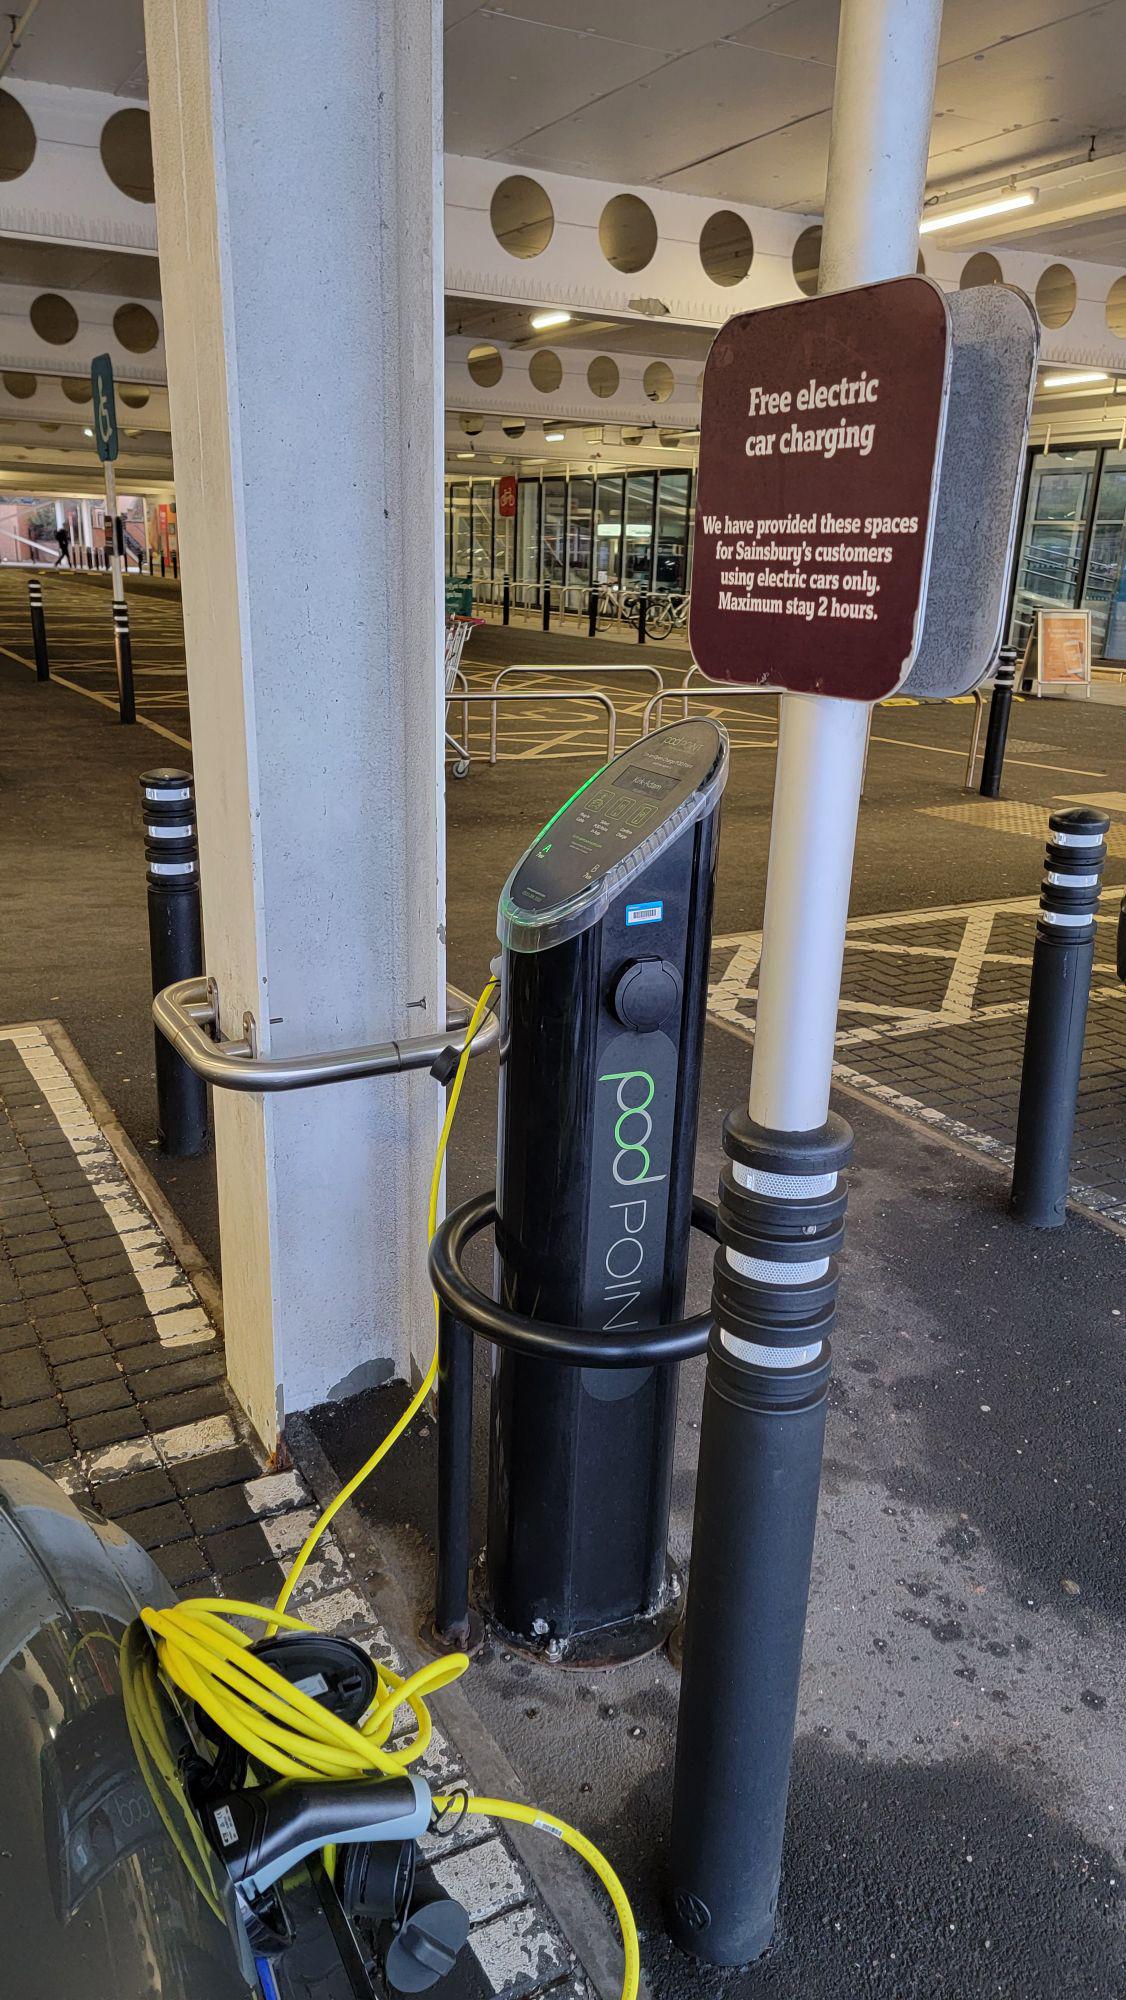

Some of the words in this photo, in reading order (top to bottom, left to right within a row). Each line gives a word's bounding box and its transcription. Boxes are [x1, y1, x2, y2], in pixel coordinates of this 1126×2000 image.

[749, 387, 791, 416] Free
[797, 371, 878, 410] electric
[746, 434, 776, 456] car
[780, 418, 875, 458] charging
[703, 516, 721, 534] We
[724, 516, 754, 534] have
[756, 514, 817, 539] provided
[821, 513, 861, 533] these
[864, 517, 918, 539] spaces
[716, 541, 733, 559] for
[736, 541, 812, 566] Sainsbury's
[815, 544, 892, 562] customers
[721, 567, 754, 590] using
[757, 568, 807, 588] electric
[810, 574, 839, 589] cars
[843, 570, 880, 596] only.
[718, 592, 782, 613] Maximum
[786, 597, 814, 620] stay
[818, 597, 828, 616] 2
[831, 597, 877, 620] hours.
[602, 1199, 647, 1331] POIN
